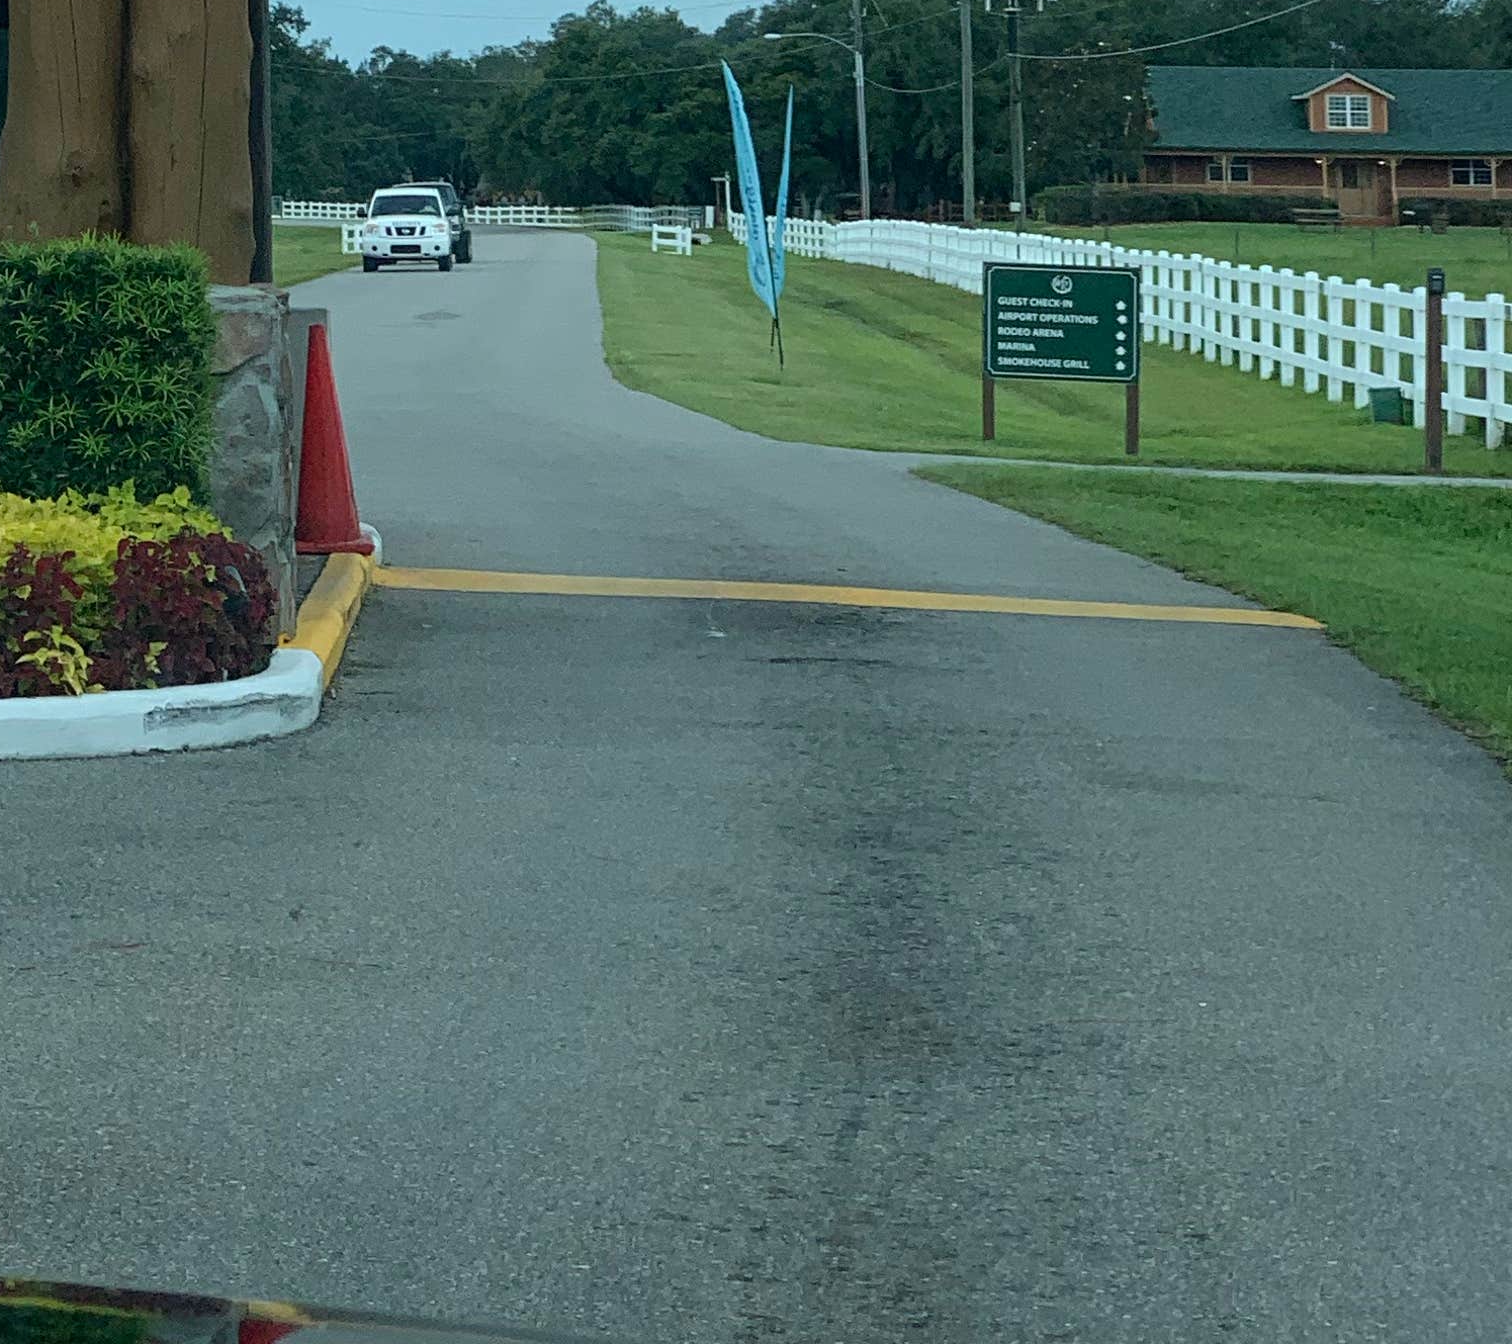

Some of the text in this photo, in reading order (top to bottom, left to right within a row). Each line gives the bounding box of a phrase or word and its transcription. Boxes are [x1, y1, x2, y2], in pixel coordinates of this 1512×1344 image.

[998, 297, 1073, 308] GUEST CHECK-IN
[998, 312, 1099, 324] AIRPORT OPERATIONS
[998, 327, 1064, 338] RODEO ARENA
[998, 342, 1036, 351] MARINA
[997, 356, 1090, 369] SMOKEHOUSE GRILL
